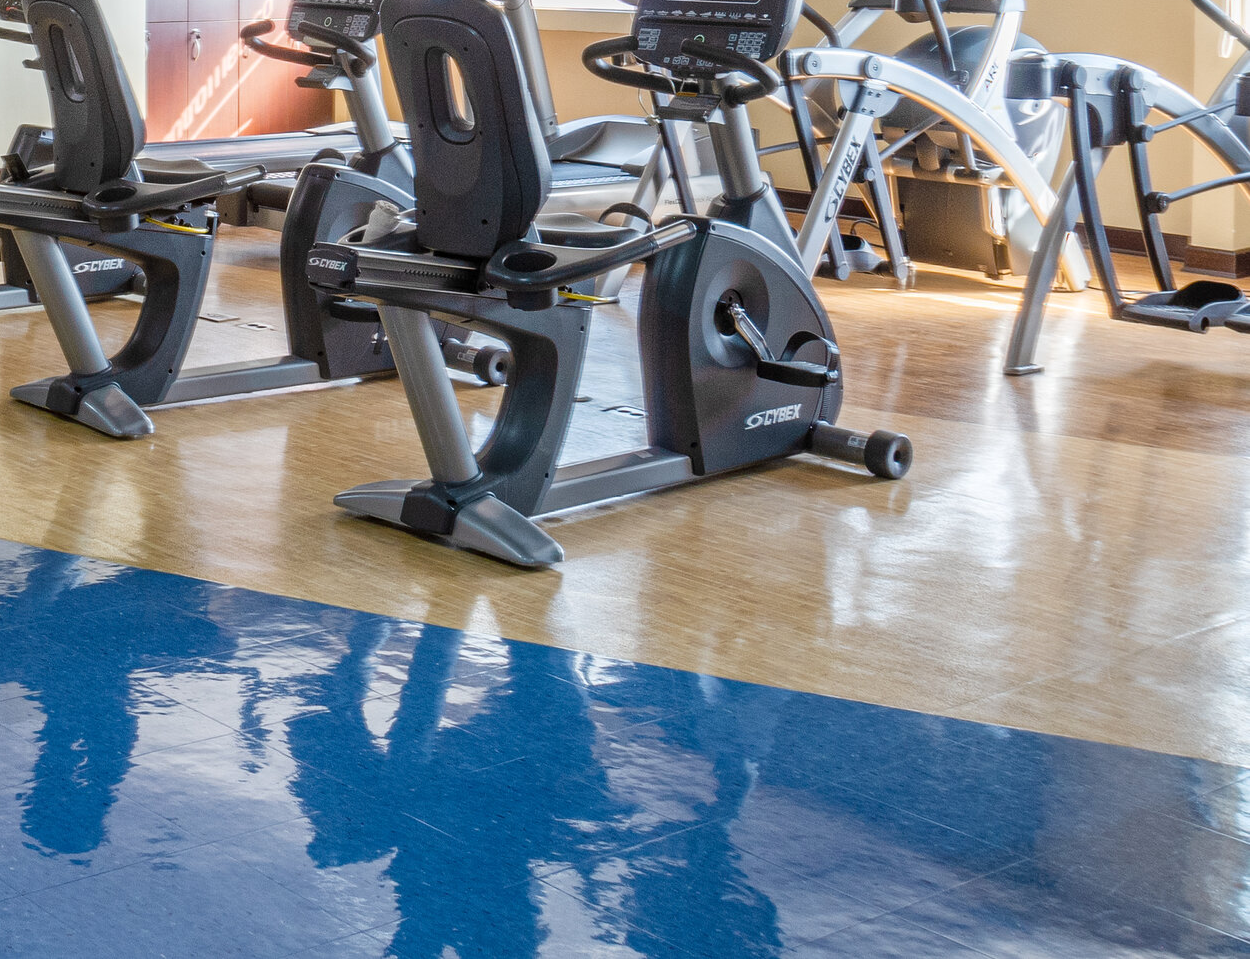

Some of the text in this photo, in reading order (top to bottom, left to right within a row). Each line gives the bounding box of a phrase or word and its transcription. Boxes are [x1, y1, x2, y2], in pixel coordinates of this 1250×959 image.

[833, 134, 861, 200] CYBEX
[89, 258, 126, 272] CYBEX
[319, 258, 347, 272] CYBEX
[764, 403, 802, 426] CYBEX
